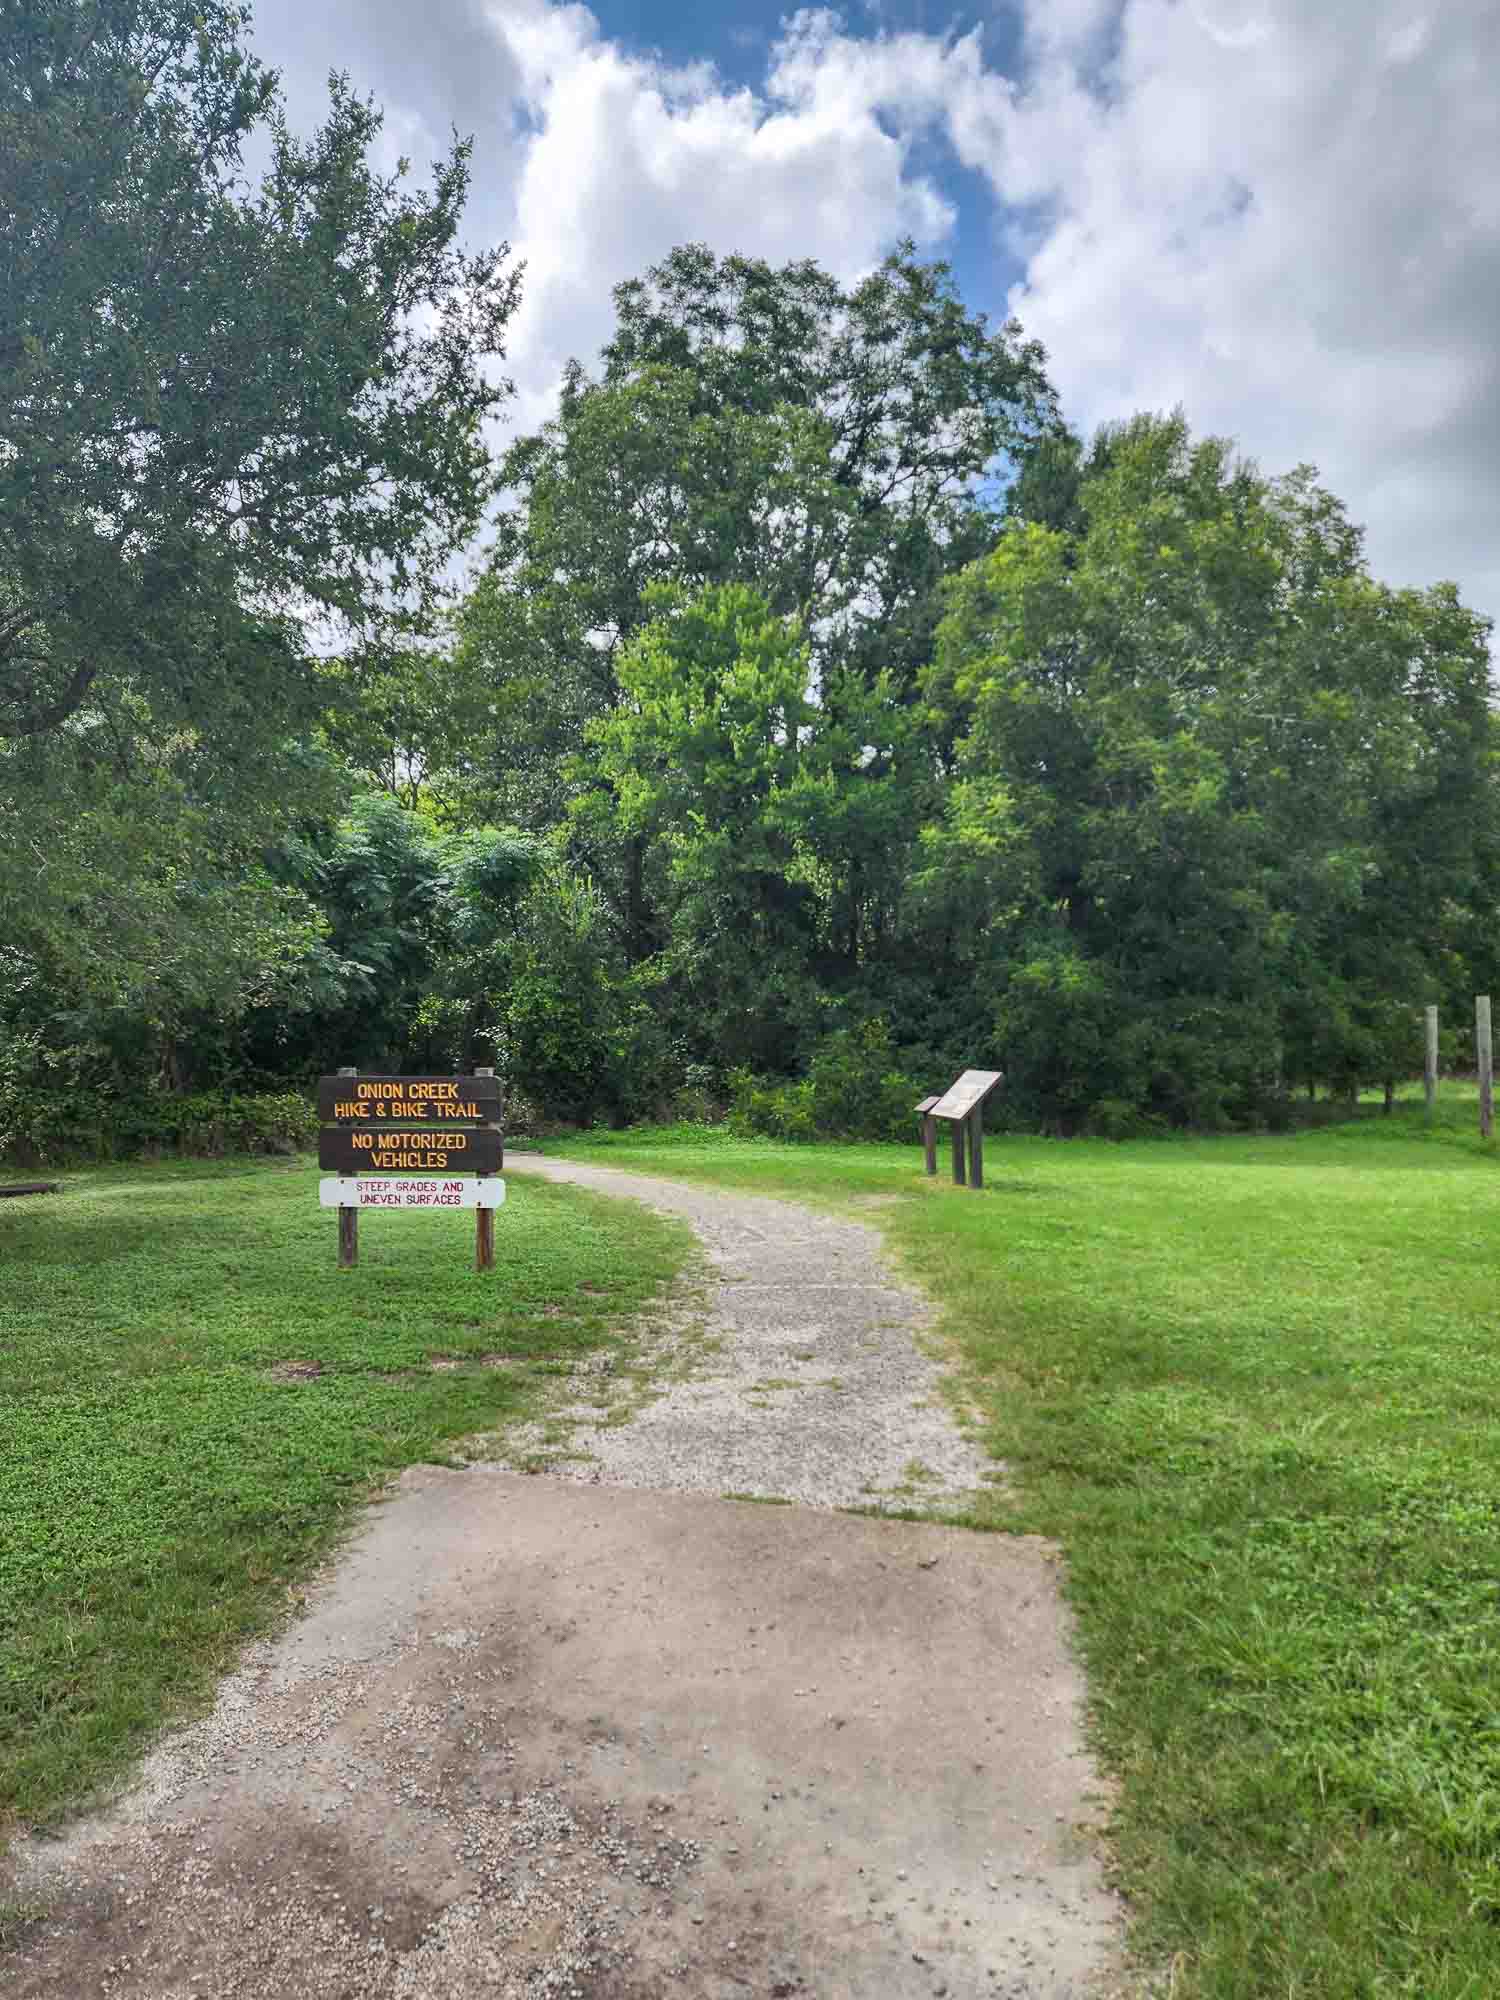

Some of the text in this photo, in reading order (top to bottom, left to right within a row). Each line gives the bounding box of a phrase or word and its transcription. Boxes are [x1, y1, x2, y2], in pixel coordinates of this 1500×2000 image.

[357, 1083, 459, 1099] ONION CREEK
[334, 1102, 483, 1117] HIKE & BIKE TRAIL
[351, 1134, 466, 1149] NO MOTORIZED
[371, 1152, 448, 1168] VEHICLES
[356, 1182, 464, 1192] STEEP GRADES AND
[360, 1195, 461, 1205] UNEVEN SURFACES
